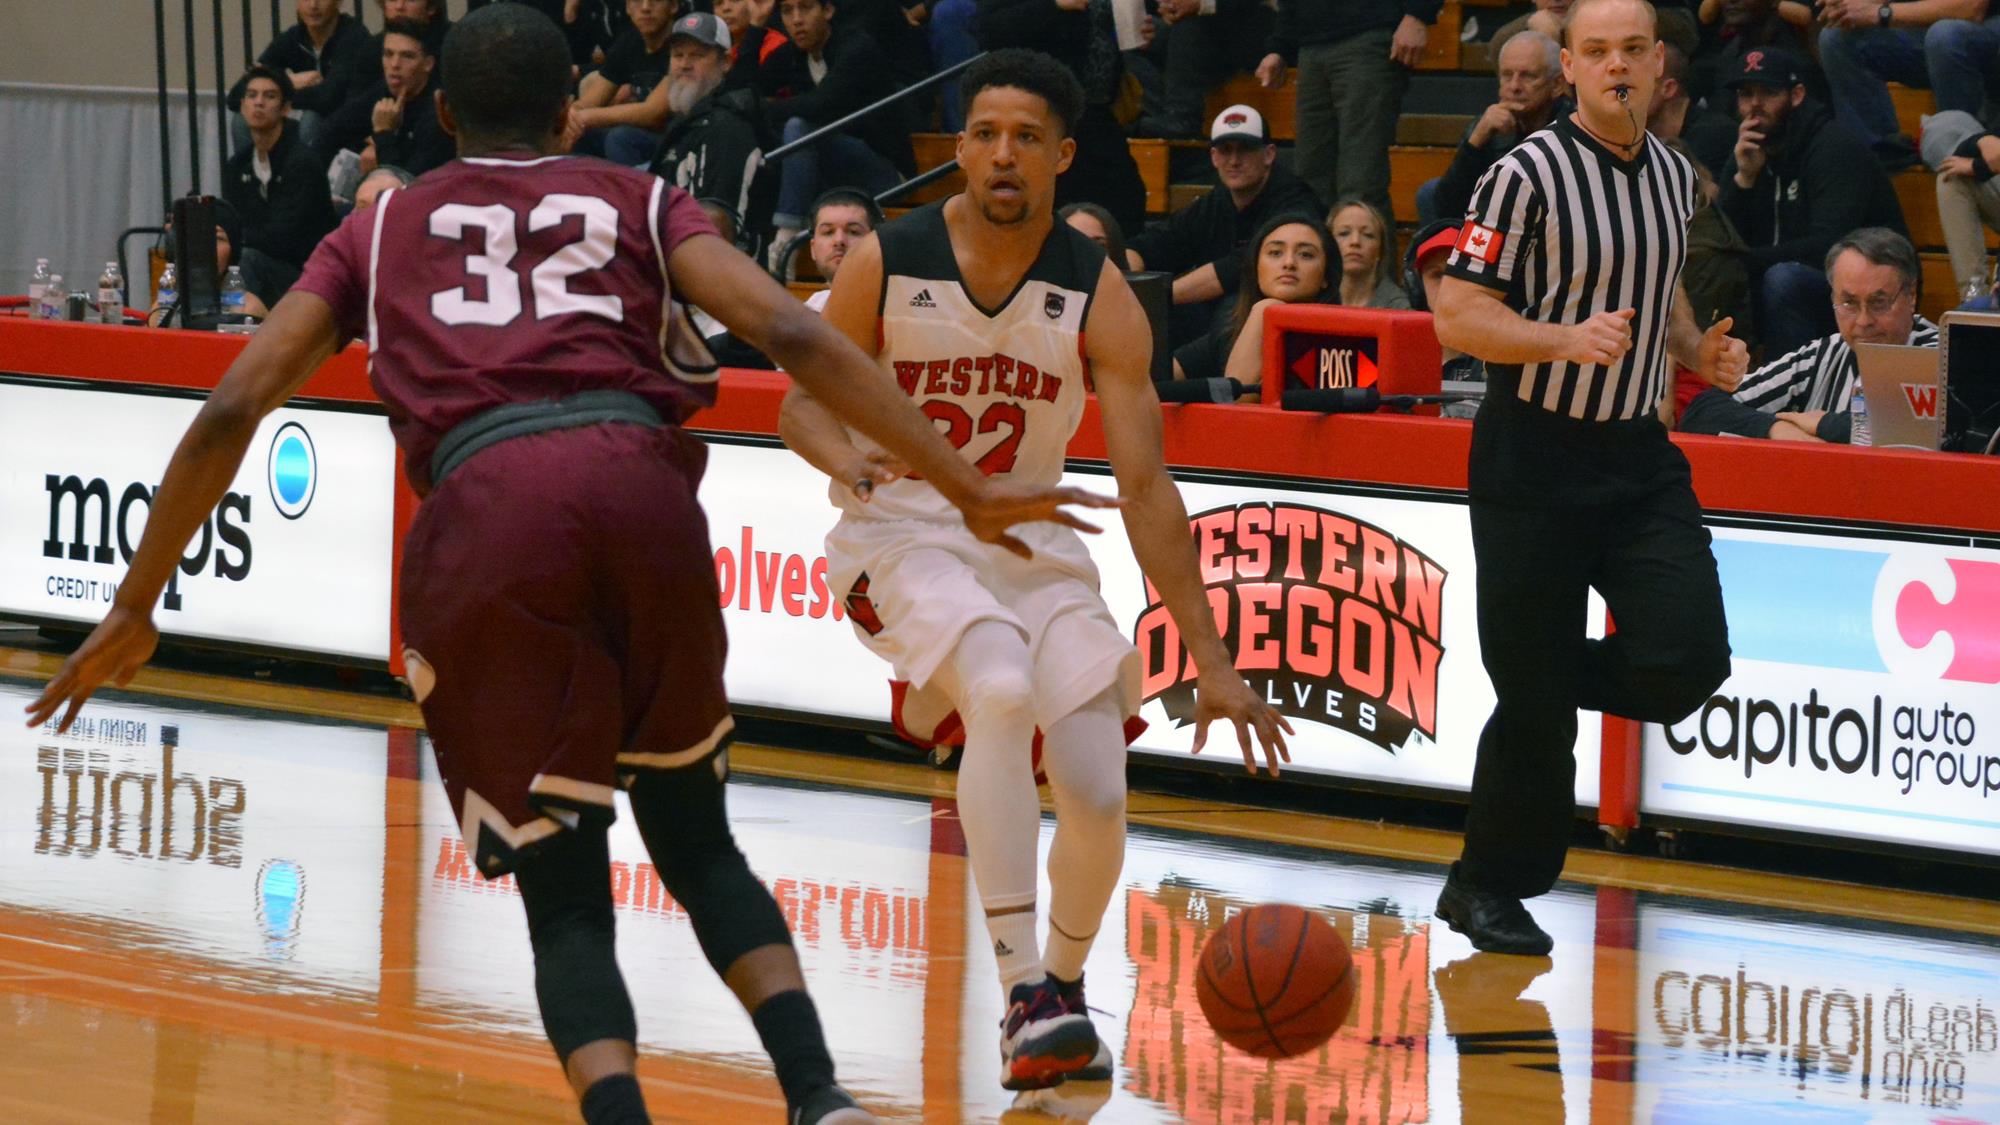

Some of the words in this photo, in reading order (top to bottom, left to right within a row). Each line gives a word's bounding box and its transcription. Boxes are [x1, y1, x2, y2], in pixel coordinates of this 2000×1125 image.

[430, 194, 624, 326] 32
[909, 300, 937, 308] adidas
[893, 352, 1063, 404] WESTERN
[1319, 348, 1353, 390] POSS
[1900, 383, 1937, 420] W
[47, 575, 98, 601] CREDIT
[1893, 702, 1976, 747] auto
[1891, 746, 2000, 798] group
